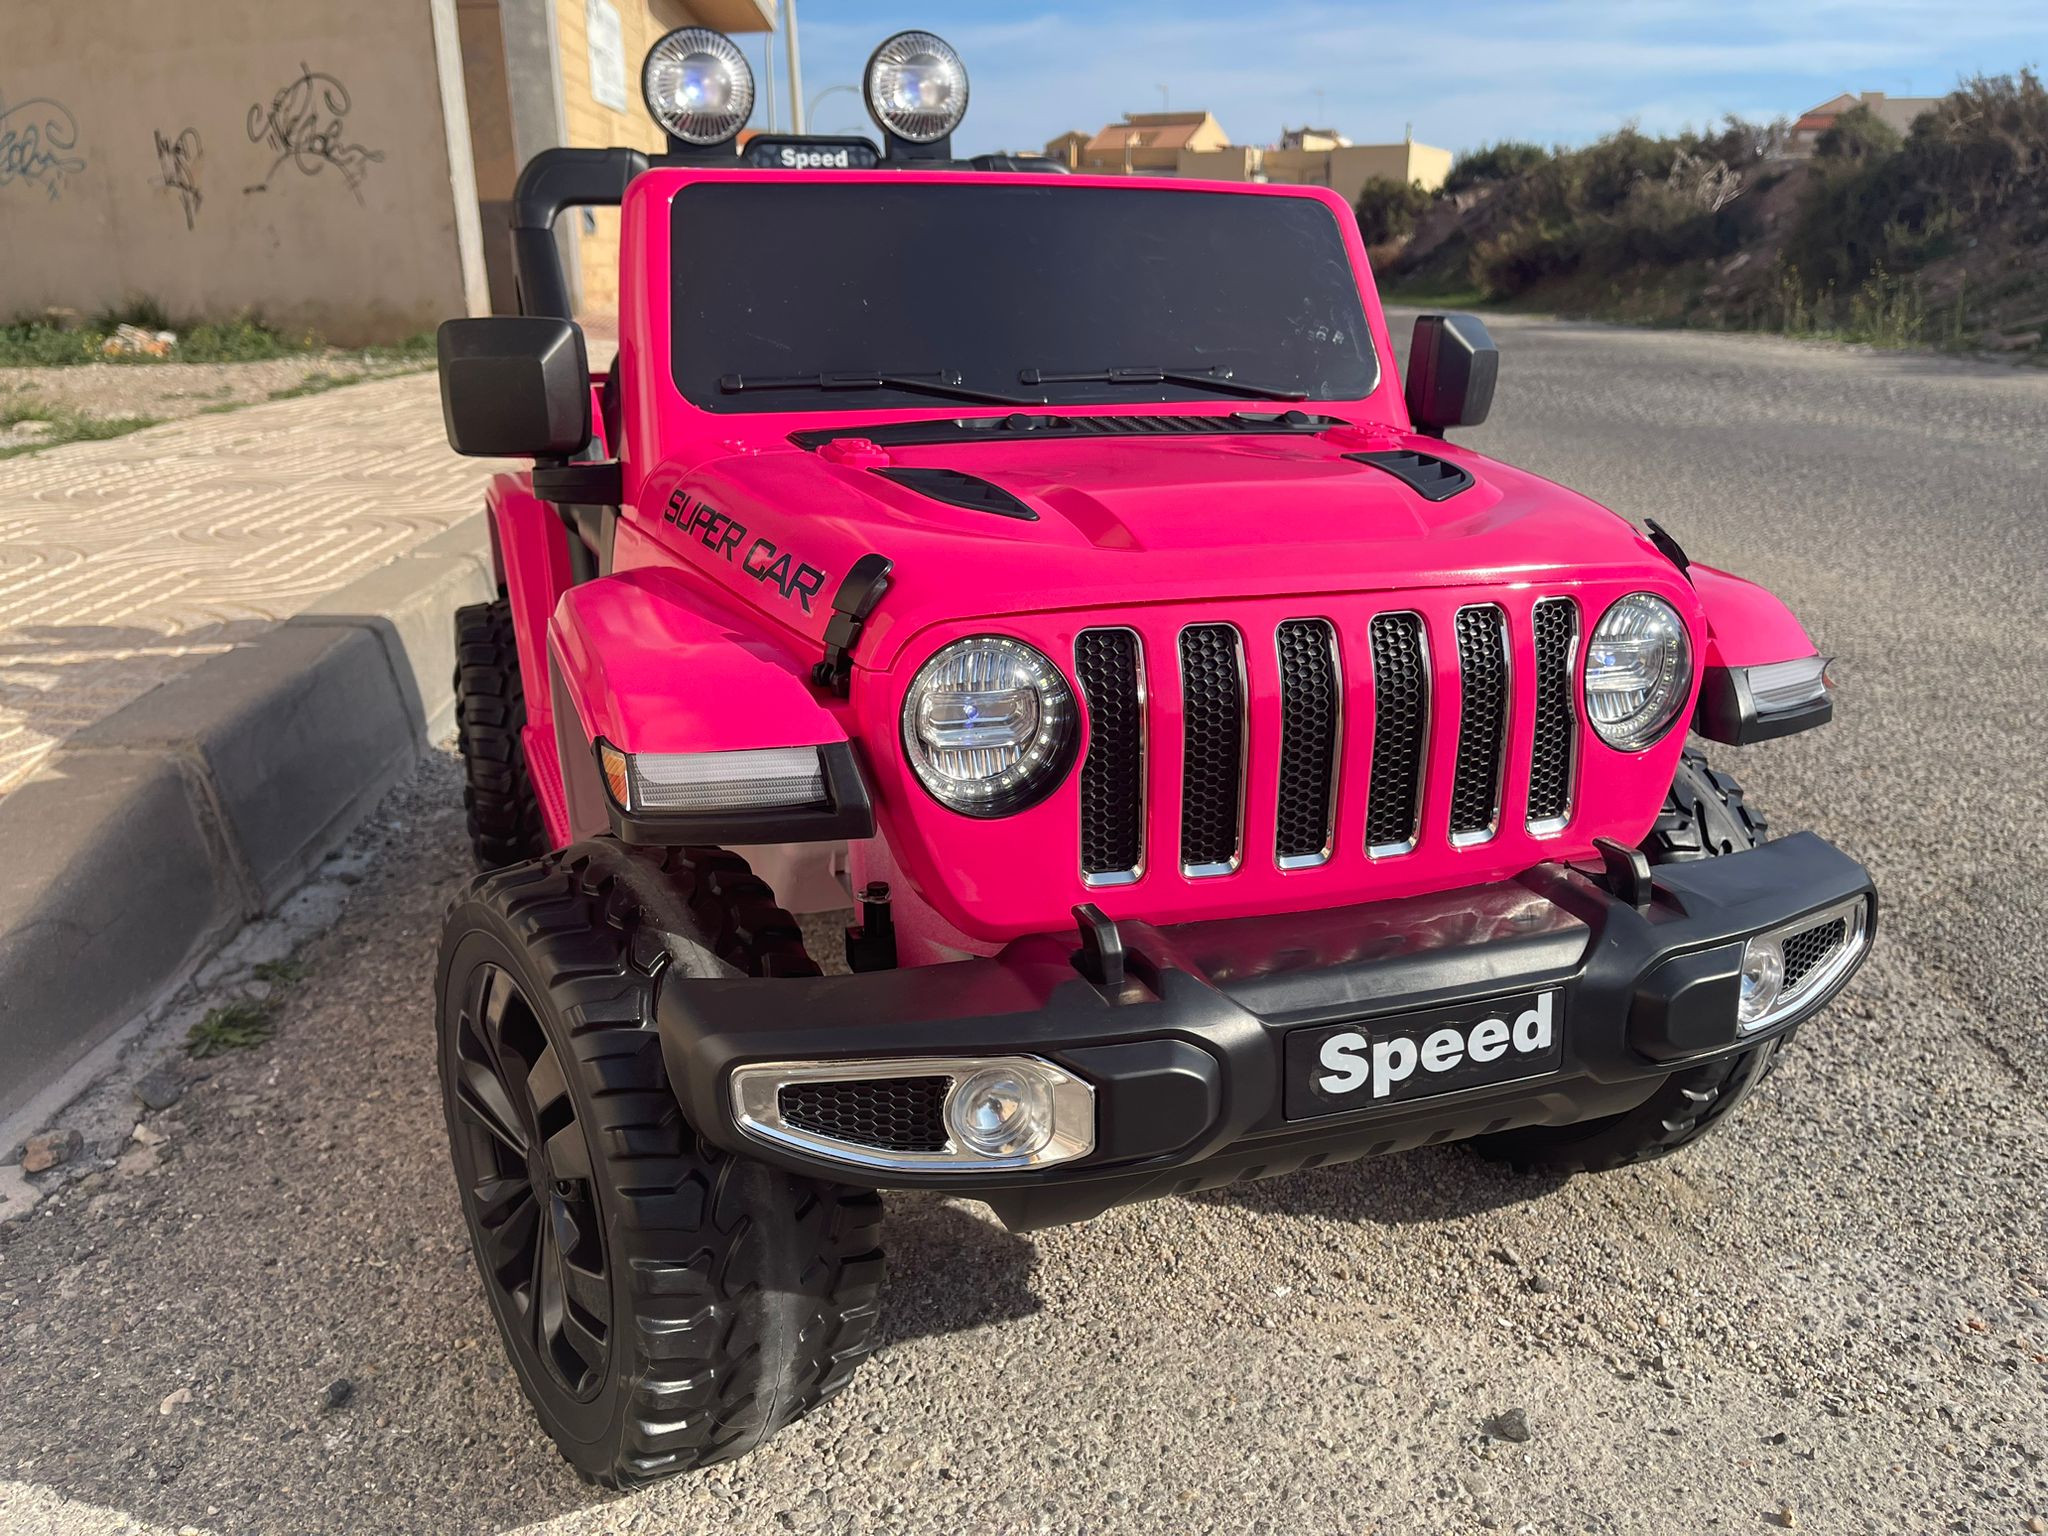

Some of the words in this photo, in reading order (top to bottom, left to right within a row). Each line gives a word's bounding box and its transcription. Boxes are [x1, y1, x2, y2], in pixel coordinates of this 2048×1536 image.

[781, 148, 848, 170] Speed
[664, 489, 747, 562] SUPER
[742, 538, 825, 614] CAR
[1319, 992, 1553, 1099] Speed
